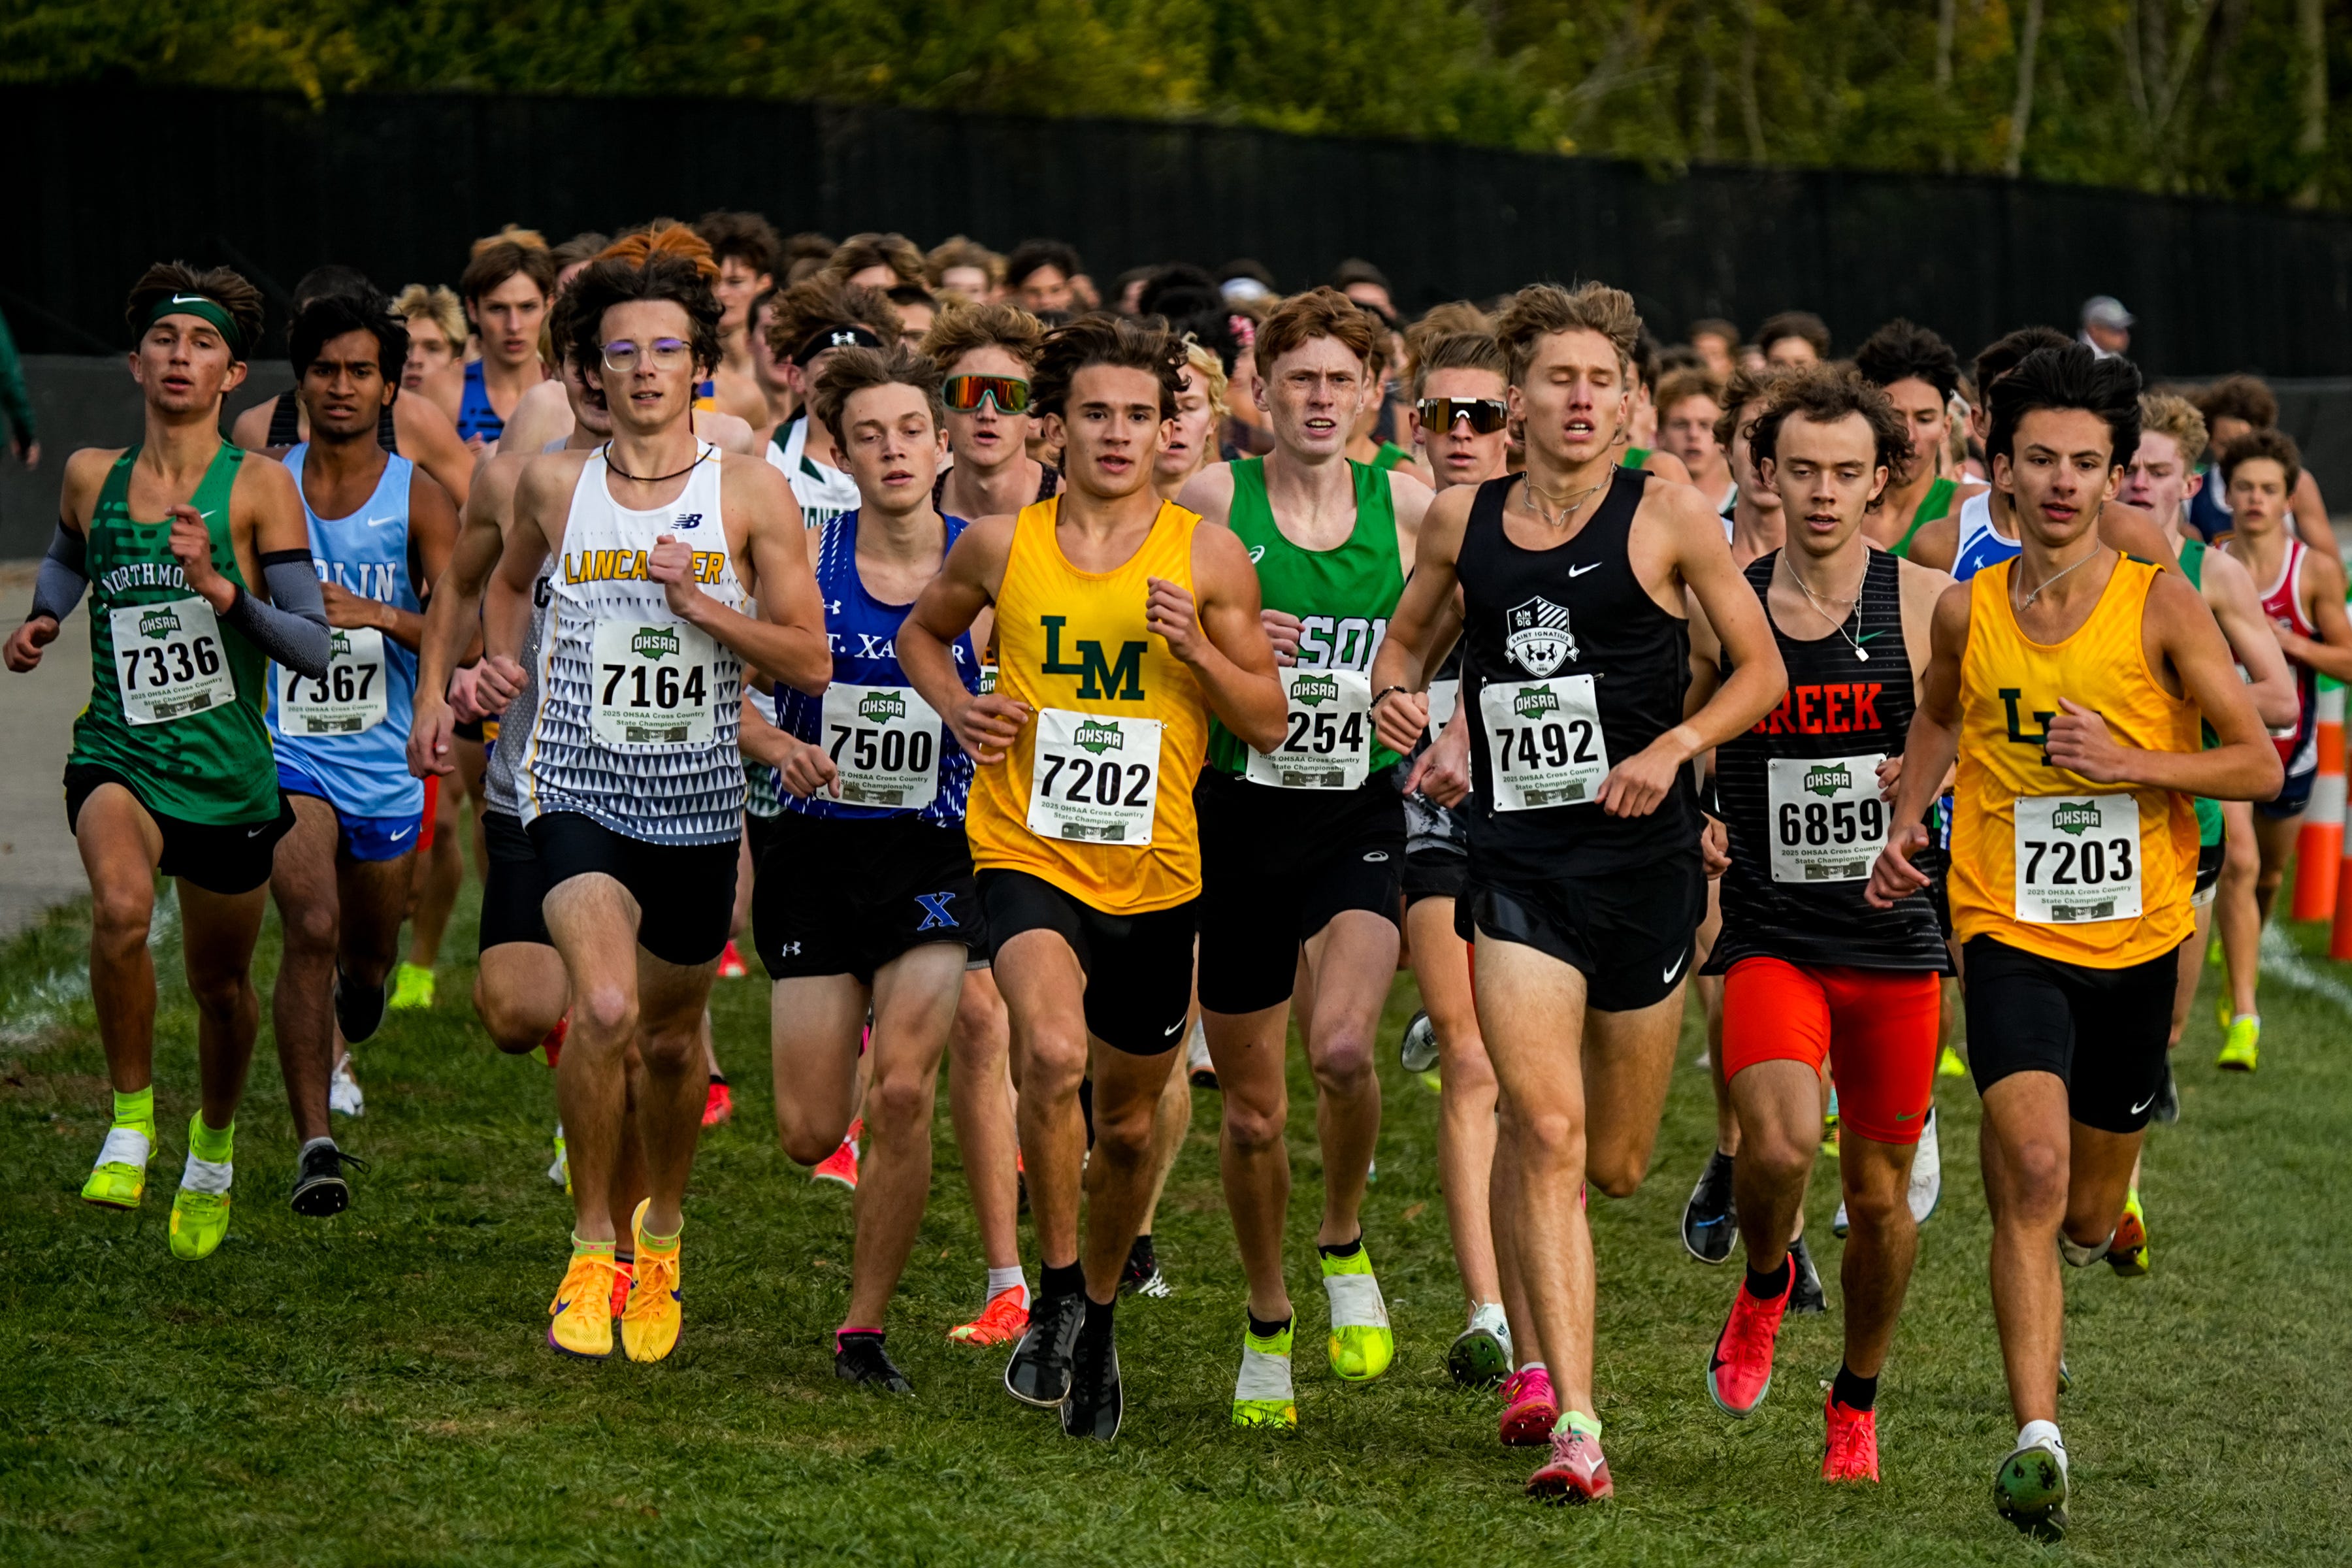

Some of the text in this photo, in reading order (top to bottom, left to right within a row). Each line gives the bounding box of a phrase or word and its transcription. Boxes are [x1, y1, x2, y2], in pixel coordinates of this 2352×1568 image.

[564, 549, 725, 585] LANCAER
[102, 563, 195, 595] NORTHMO
[141, 616, 179, 633] OHSAA
[634, 635, 678, 652] OHSAA
[1512, 631, 1569, 644] SAINT IGNATIUS
[854, 633, 966, 664] XAR
[122, 636, 220, 690] 7336
[1040, 615, 1148, 701] LM
[148, 688, 171, 698] OHSAA
[173, 685, 193, 693] Cross
[195, 676, 223, 689] Country
[286, 663, 378, 703] 7367
[602, 664, 706, 709] 7164
[1293, 683, 1336, 697] OHSAA
[163, 687, 212, 705] Championship
[1516, 695, 1556, 711] OHSAA
[676, 710, 705, 719] Country
[861, 700, 904, 714] OHSAA
[1751, 683, 1882, 734] REEK
[638, 719, 692, 728] Championship
[1284, 711, 1364, 753] 254
[1077, 729, 1122, 747] OHSAA
[1495, 719, 1599, 772] 7492
[830, 724, 932, 773] 7500
[847, 772, 874, 780] OHSAA
[1294, 763, 1346, 772] Championship
[1570, 766, 1600, 776] Country
[862, 781, 914, 791] Championship
[1041, 754, 1151, 807] 7202
[1535, 776, 1588, 789] Championship
[1806, 773, 1850, 789] OHSAA
[1041, 802, 1058, 810] 2025
[1061, 804, 1087, 814] OHSAA
[1114, 810, 1144, 819] Country
[1054, 812, 1130, 826] State Championship
[2054, 810, 2099, 826] OHSAA
[1778, 798, 1884, 846] 6859
[1817, 855, 1870, 864] Championship
[2024, 838, 2133, 884] 7203
[2102, 885, 2132, 894] Country
[2065, 894, 2118, 904] Championship
[915, 892, 960, 931] X
